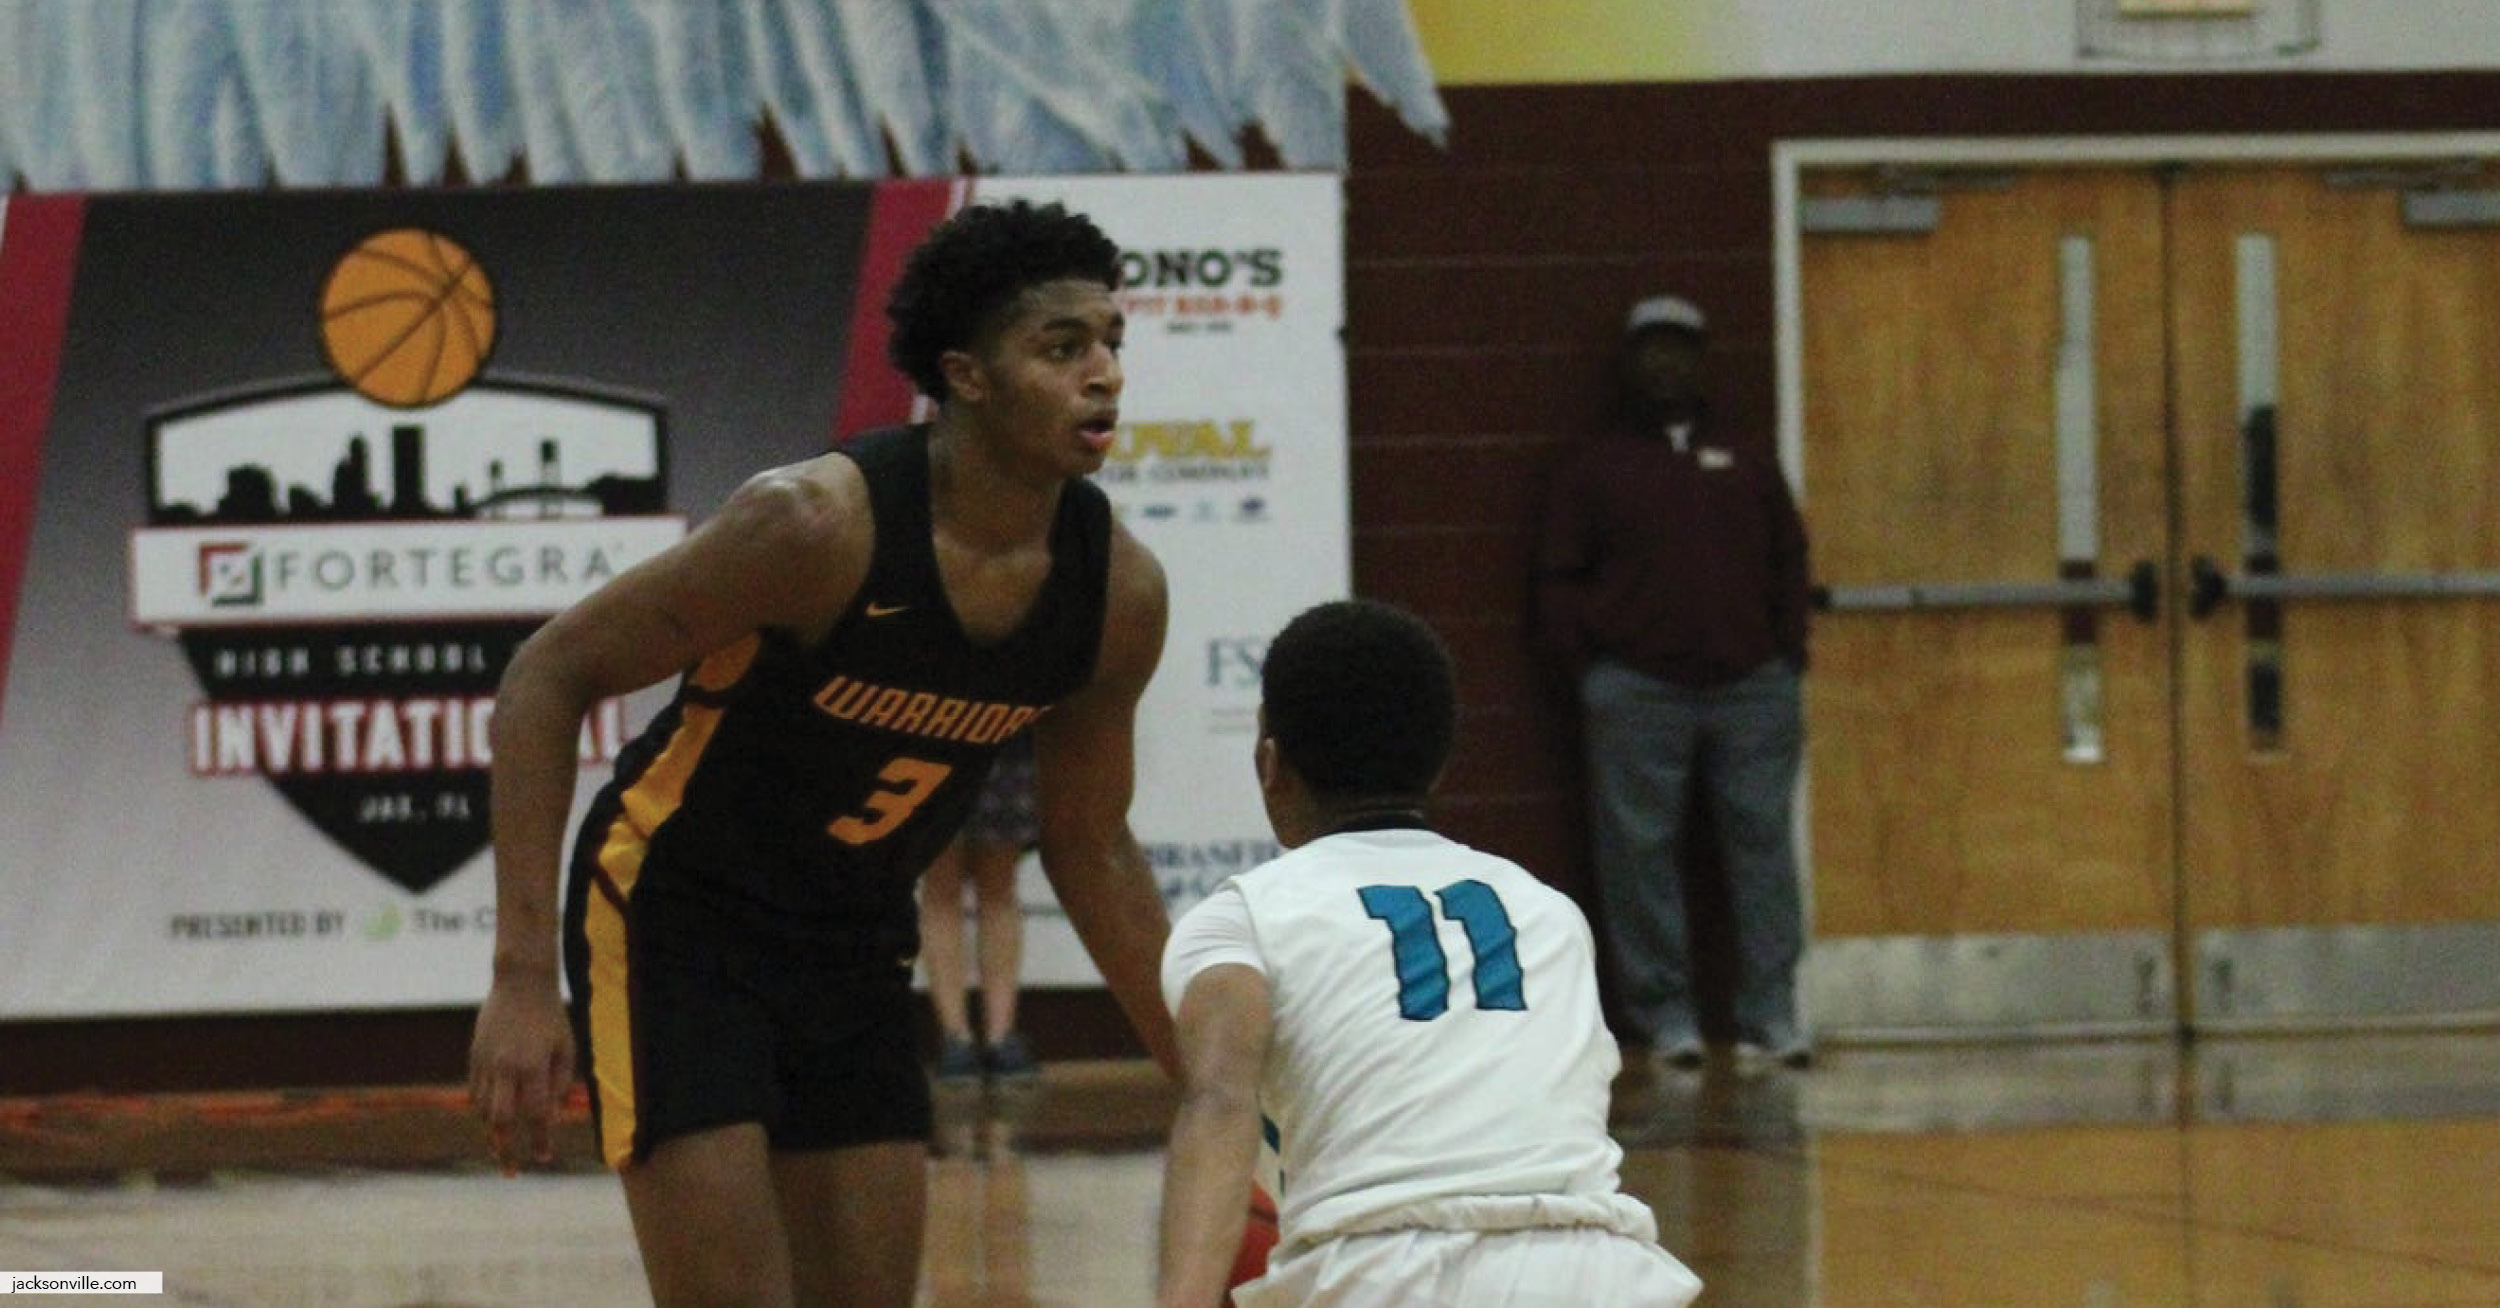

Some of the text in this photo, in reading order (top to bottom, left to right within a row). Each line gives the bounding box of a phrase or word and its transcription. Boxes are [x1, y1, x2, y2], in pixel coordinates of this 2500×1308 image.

[277, 547, 613, 591] FORTEGRA
[336, 643, 487, 674] SCHOOL
[813, 675, 1054, 744] WARRIOR
[825, 755, 953, 846] 3
[169, 910, 306, 939] PRESENTED
[316, 909, 344, 935] BY
[1356, 878, 1530, 1023] 11
